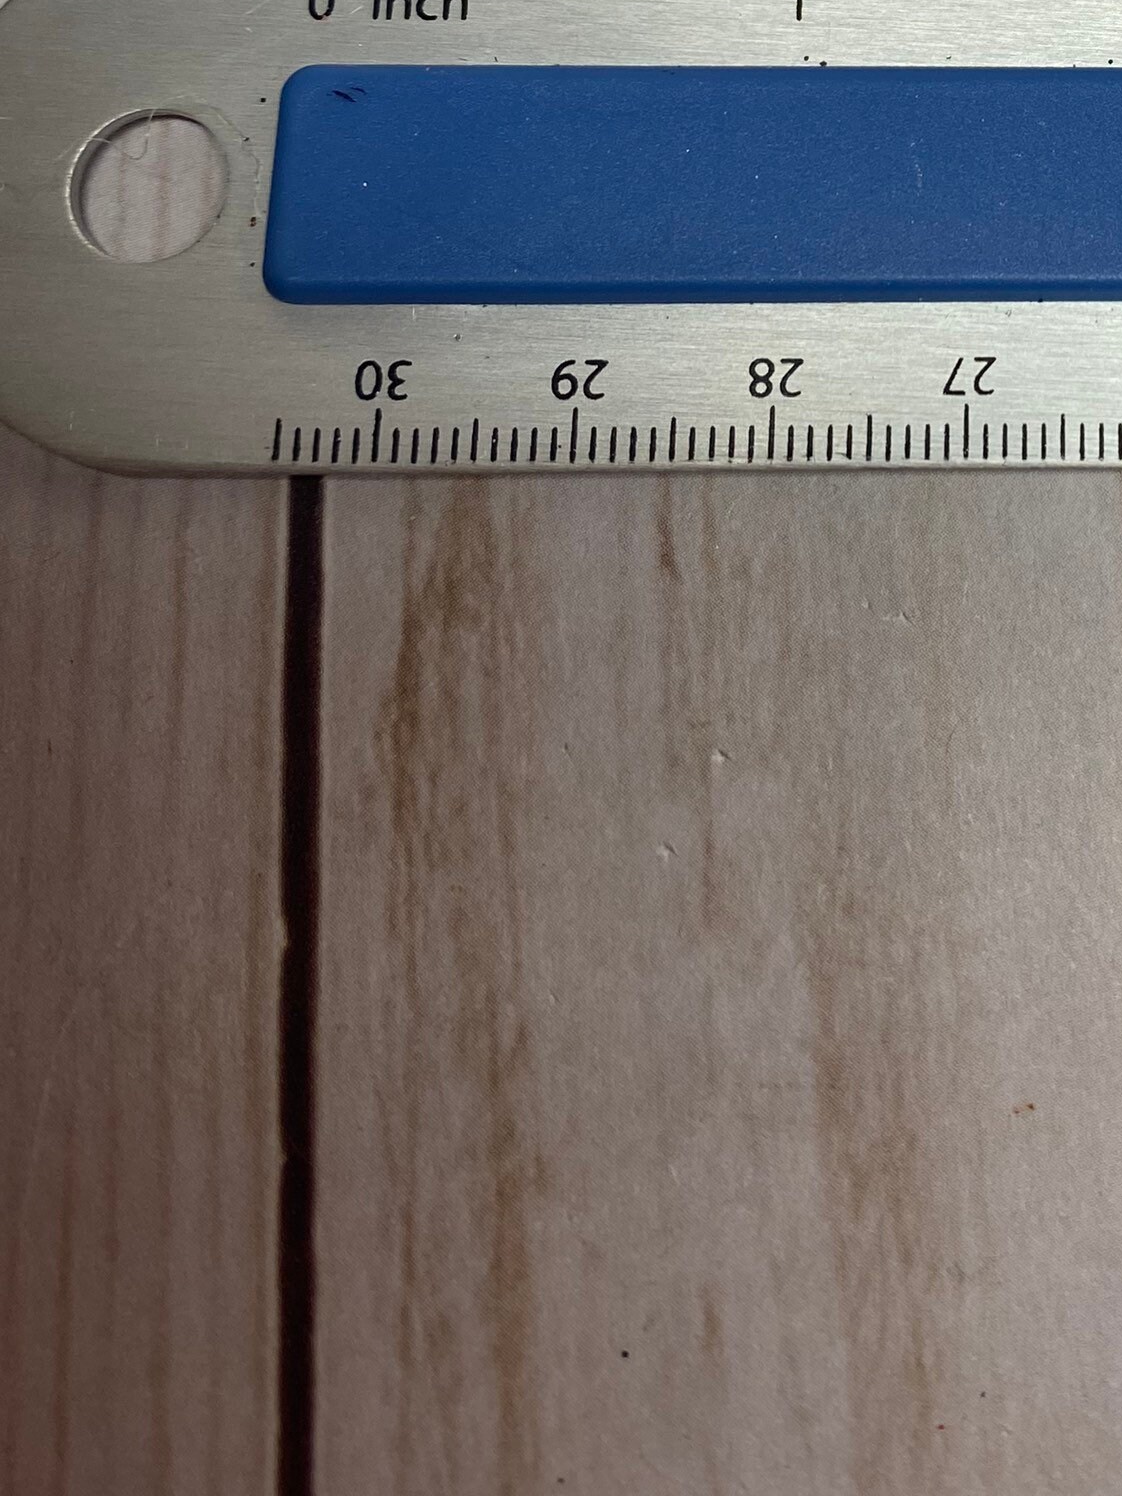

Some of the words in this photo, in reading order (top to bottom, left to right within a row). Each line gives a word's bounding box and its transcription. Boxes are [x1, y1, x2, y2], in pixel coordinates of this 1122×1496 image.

[354, 359, 413, 401] 30
[550, 359, 610, 401] 29
[748, 357, 805, 399] 28
[942, 356, 997, 397] 27
